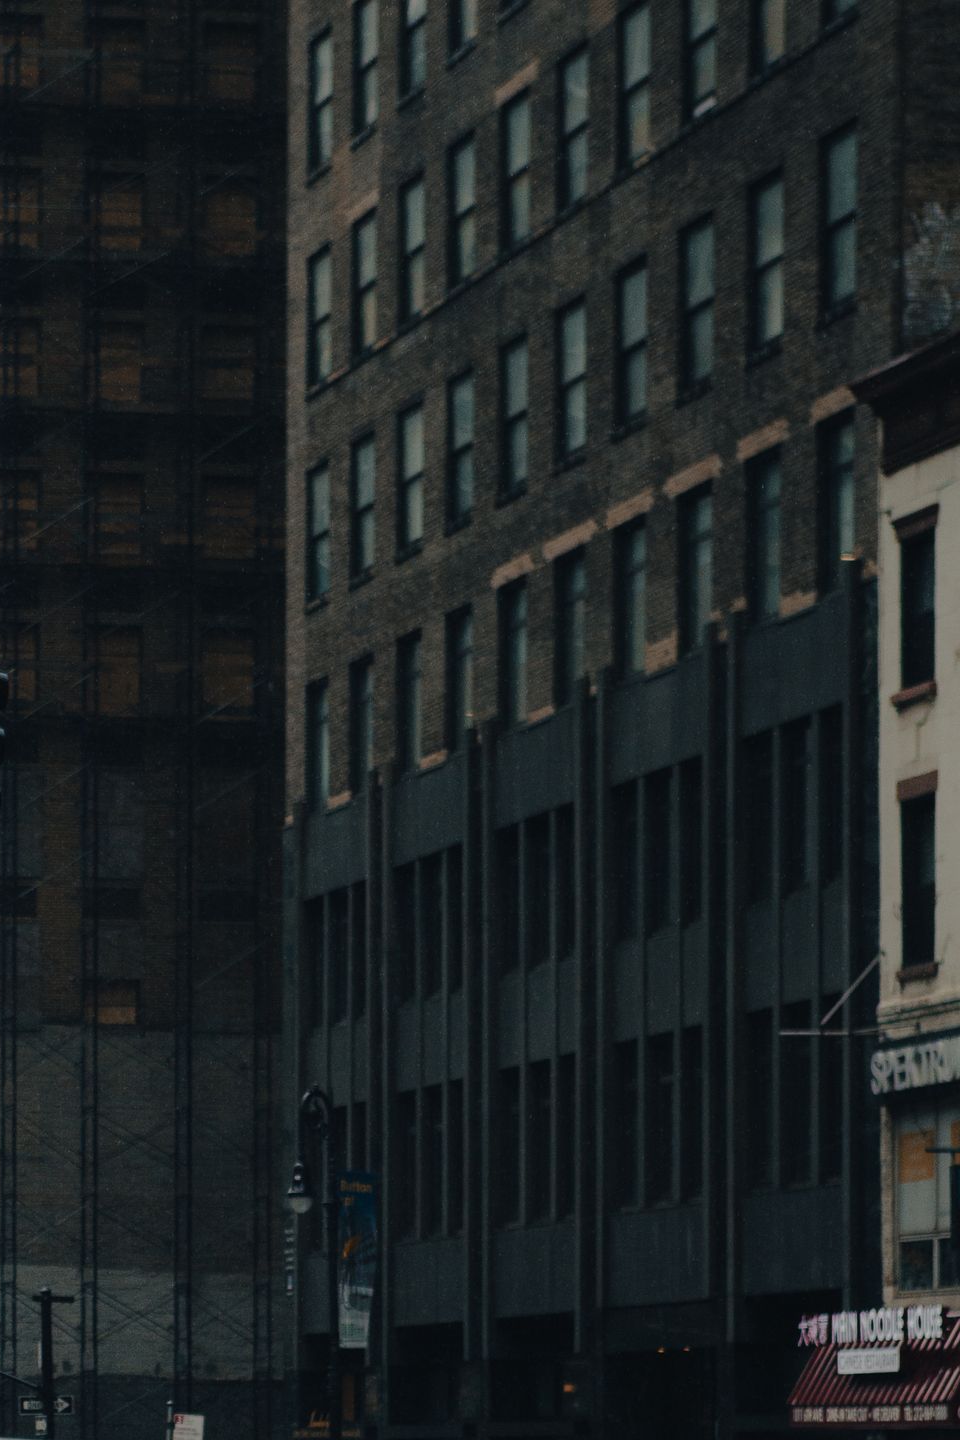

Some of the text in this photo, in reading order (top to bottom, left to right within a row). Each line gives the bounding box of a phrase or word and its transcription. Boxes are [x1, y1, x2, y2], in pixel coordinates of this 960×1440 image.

[832, 1312, 858, 1344] MAIN
[860, 1307, 904, 1345] NOODLE
[907, 1304, 943, 1343] HOUSE
